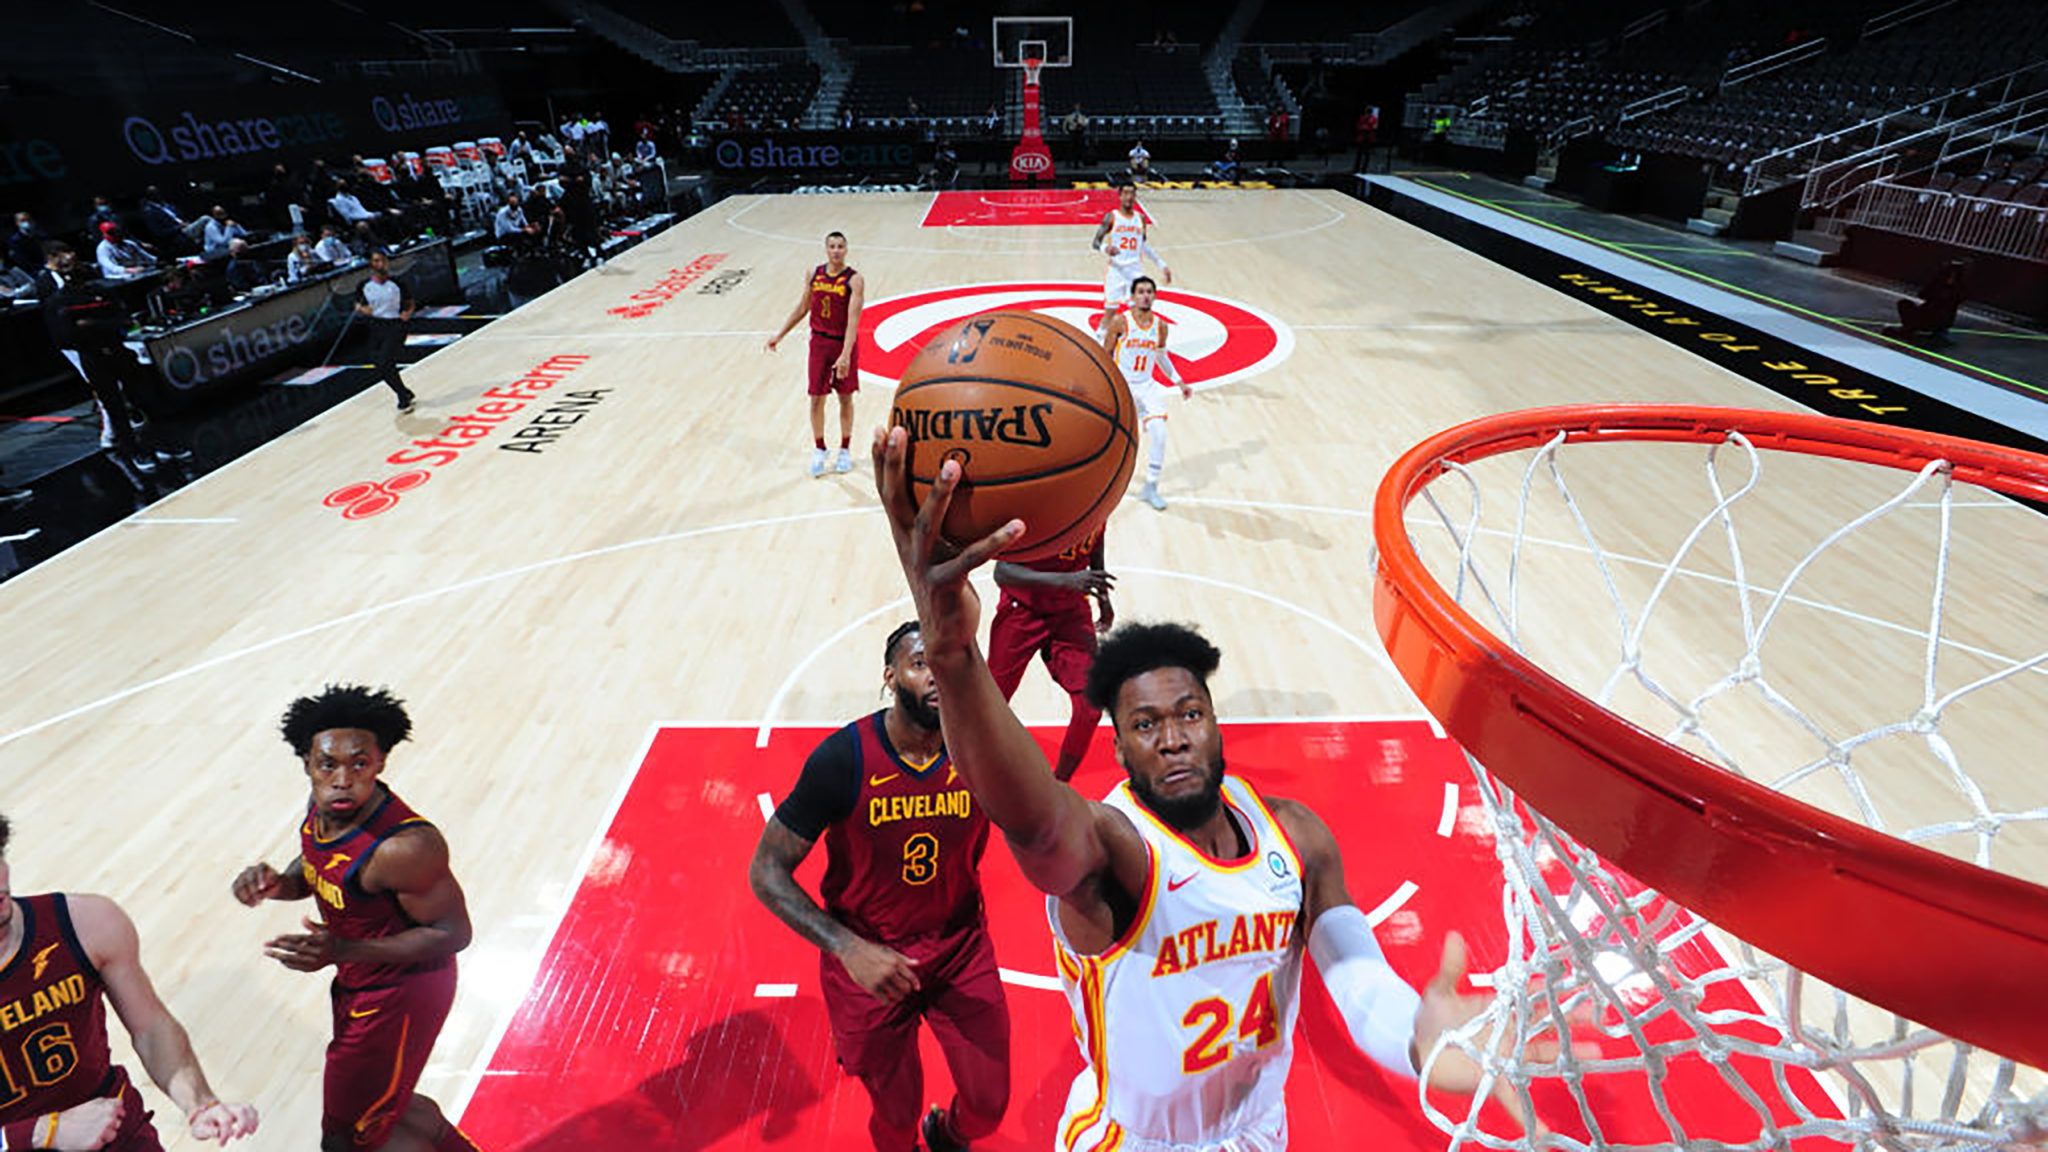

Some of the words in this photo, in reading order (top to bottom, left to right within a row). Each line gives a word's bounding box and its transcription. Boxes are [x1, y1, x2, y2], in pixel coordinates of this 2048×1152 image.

[1018, 156, 1047, 171] KIA
[1120, 236, 1137, 250] 20
[821, 295, 831, 318] 1
[1699, 333, 1760, 352] TO
[1133, 354, 1147, 372] 11
[1762, 360, 1909, 415] TRUE
[386, 354, 590, 467] StateFarm
[498, 388, 614, 453] ARENA
[869, 789, 970, 827] CLEVELAND
[902, 832, 939, 886] 3
[1182, 972, 1280, 1075] 24
